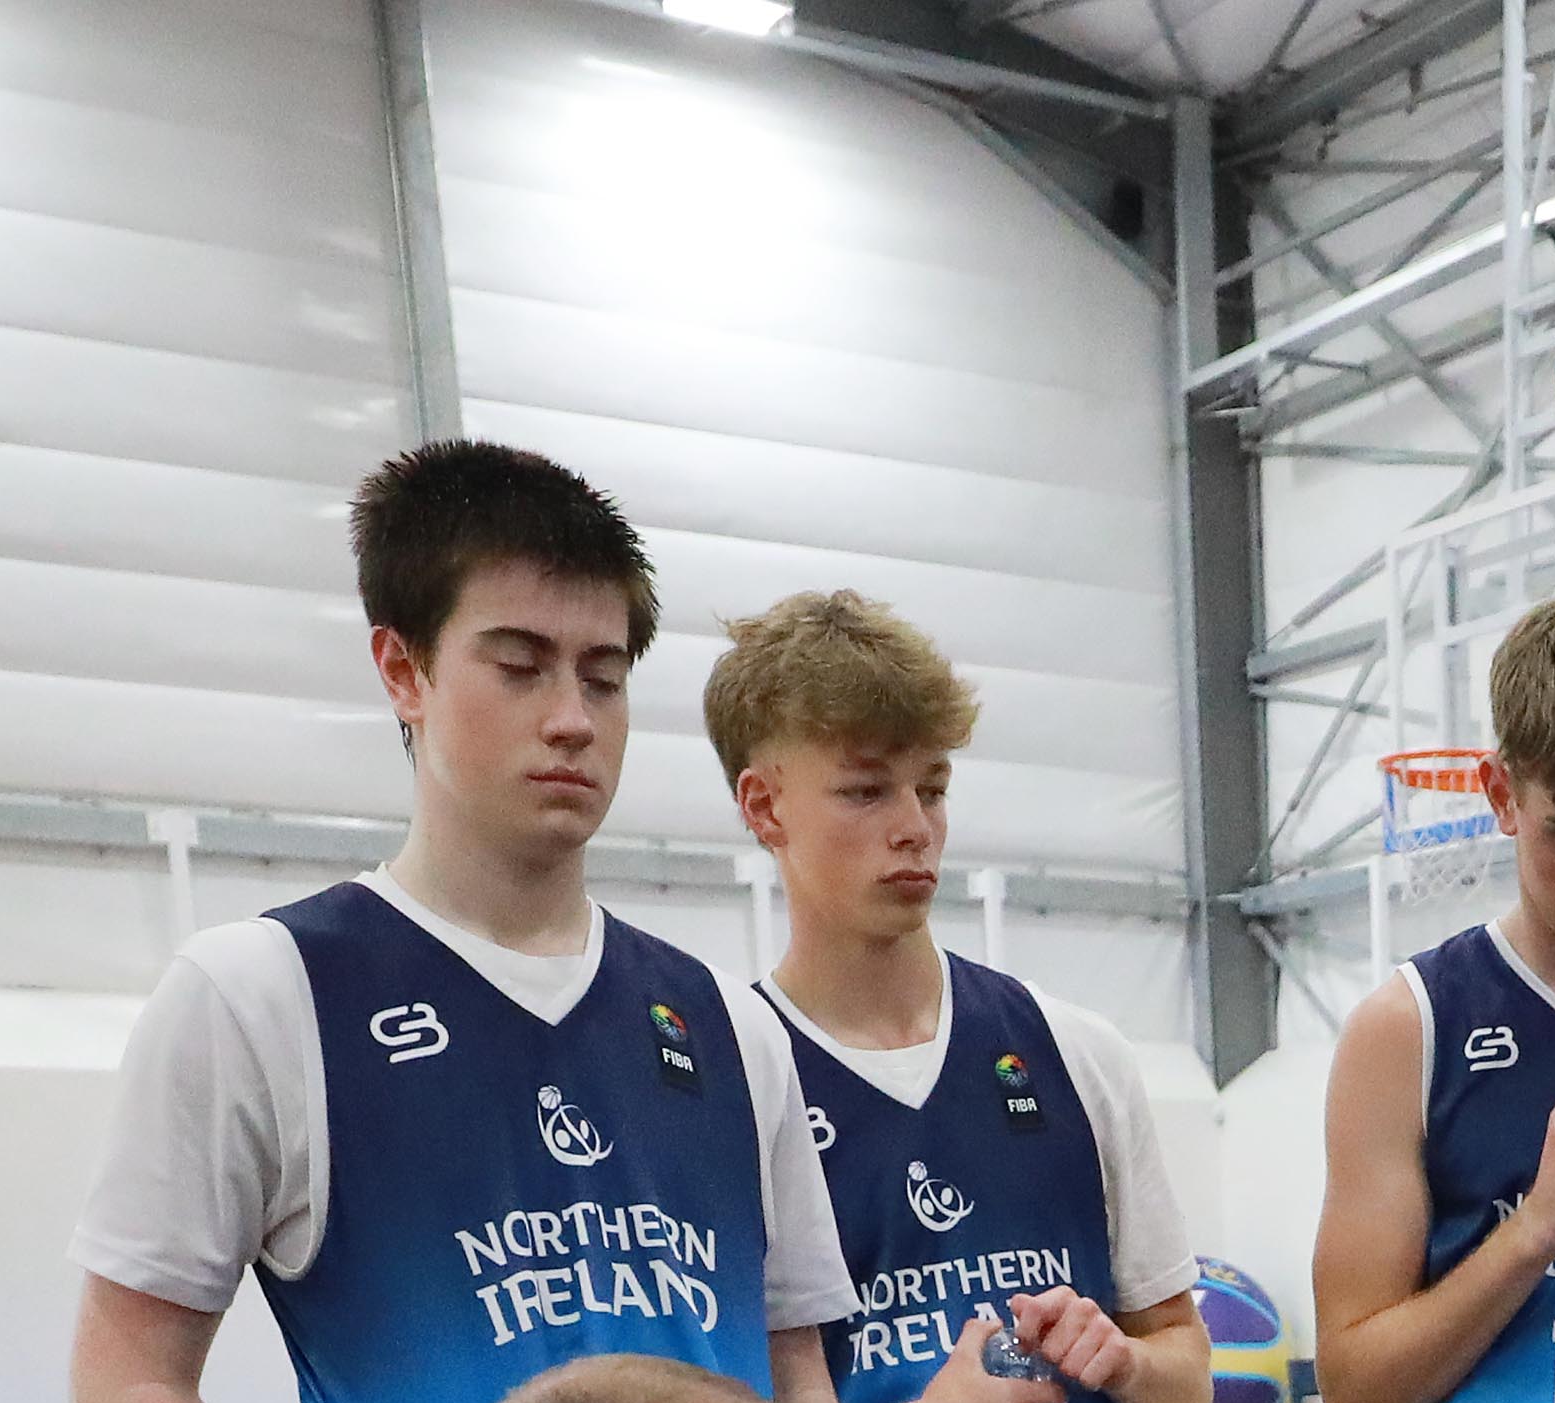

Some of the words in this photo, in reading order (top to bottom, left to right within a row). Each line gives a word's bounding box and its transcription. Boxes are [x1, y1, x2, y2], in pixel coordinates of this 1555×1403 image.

[662, 1047, 694, 1073] FIBA
[1007, 1097, 1038, 1114] FIBA
[454, 1202, 716, 1275] NORTHERN
[476, 1258, 718, 1346] IRELAND
